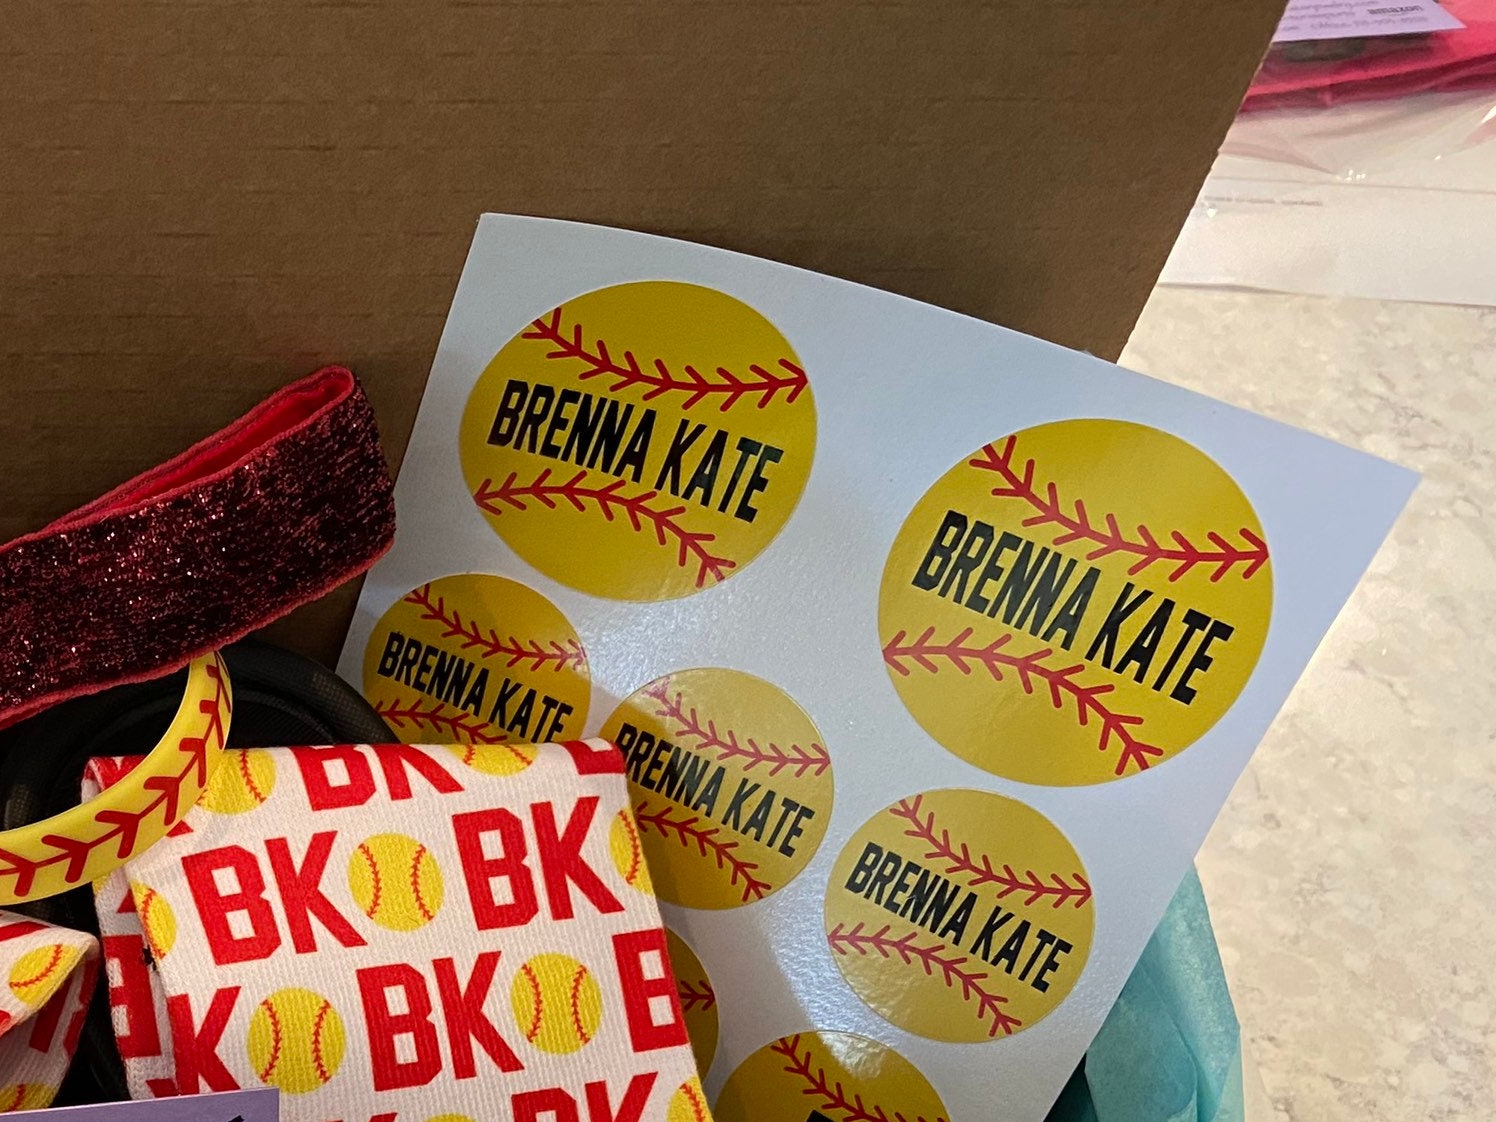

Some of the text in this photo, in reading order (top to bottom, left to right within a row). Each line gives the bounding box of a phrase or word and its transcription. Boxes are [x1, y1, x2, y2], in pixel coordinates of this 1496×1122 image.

[487, 379, 784, 523] BRENNA KATE
[911, 509, 1233, 705] BRENNA KATE
[377, 631, 573, 743] BRENNA KATE
[615, 722, 815, 858] BRENNA KATE
[181, 830, 368, 966] BK
[452, 796, 625, 931] BK
[844, 842, 1073, 993] BRENNA KATE
[166, 986, 242, 1099] K
[356, 951, 525, 1093] BK
